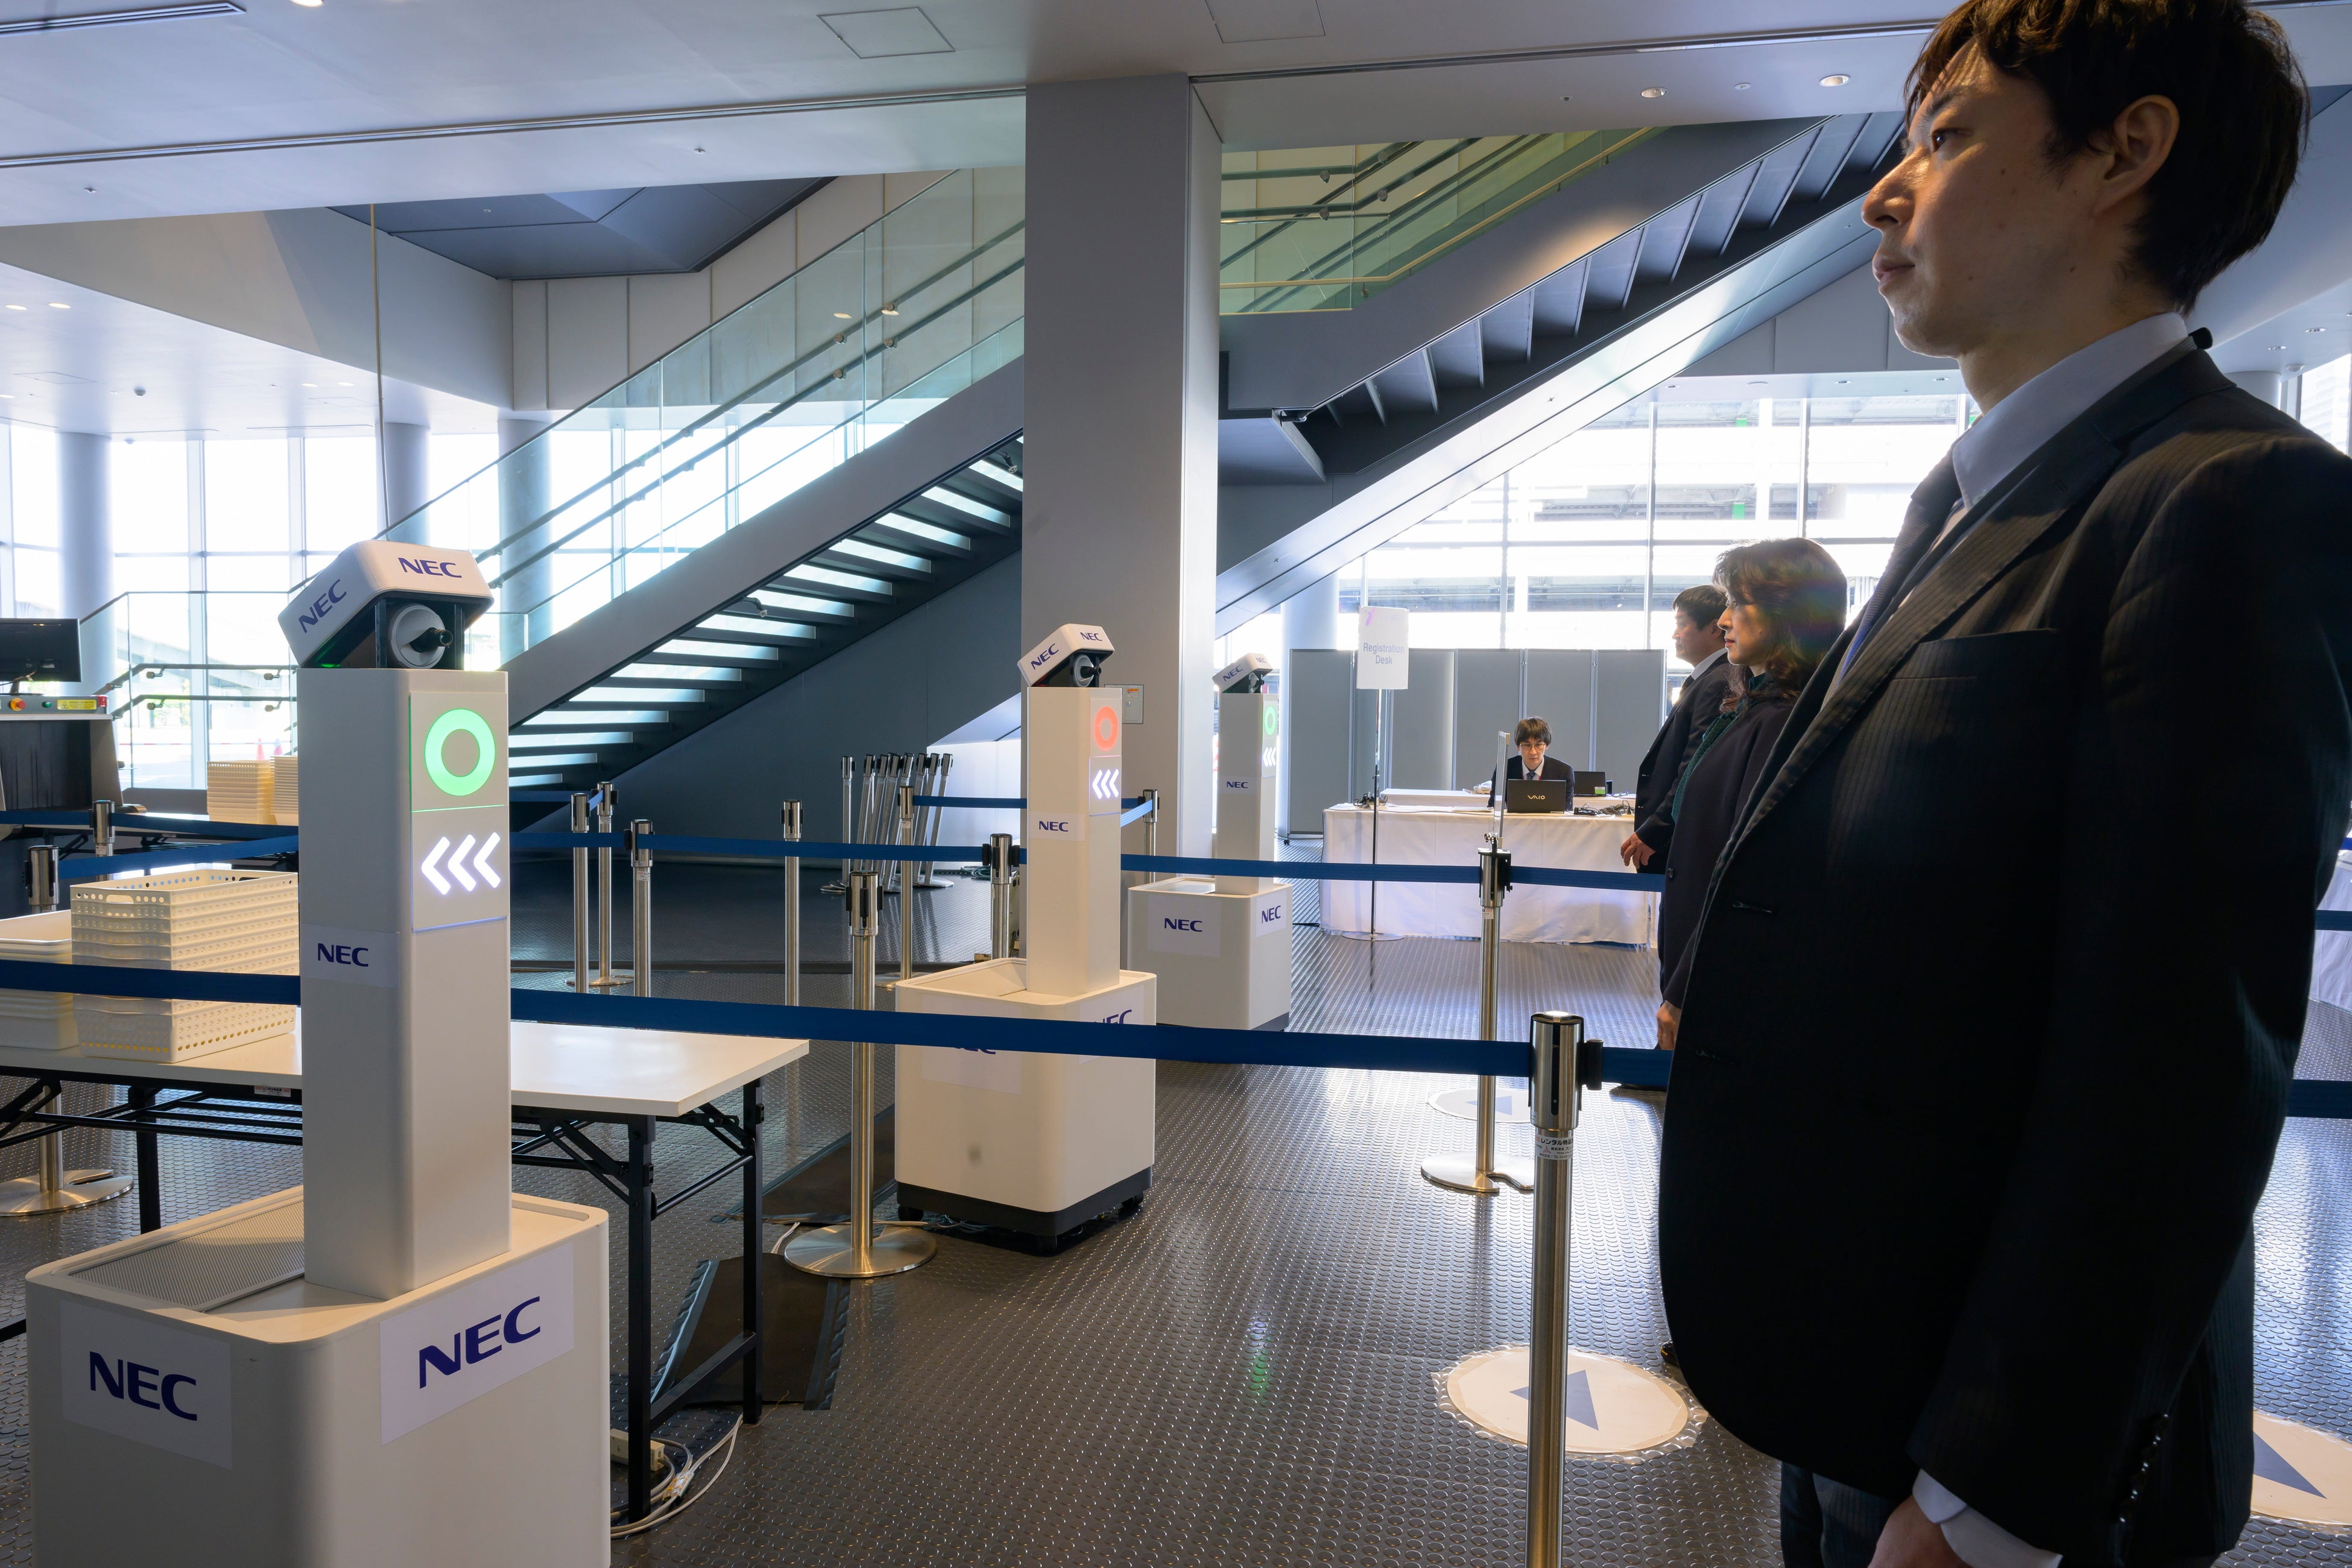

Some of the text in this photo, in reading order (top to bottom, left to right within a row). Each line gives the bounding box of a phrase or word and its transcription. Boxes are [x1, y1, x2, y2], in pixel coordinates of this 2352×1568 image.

[398, 557, 462, 578] NEC
[298, 579, 347, 633] NEC
[1080, 632, 1102, 641] NEC
[1030, 643, 1059, 669] NEC
[1363, 642, 1405, 654] Registration
[1376, 655, 1393, 665] Desk
[1222, 665, 1244, 681] NEC
[1039, 821, 1068, 832] NEC
[1262, 905, 1281, 924] NEC
[1164, 918, 1203, 932] NEC
[317, 943, 369, 967] NEC
[418, 1296, 541, 1389] NEC
[89, 1351, 197, 1421] NEC
